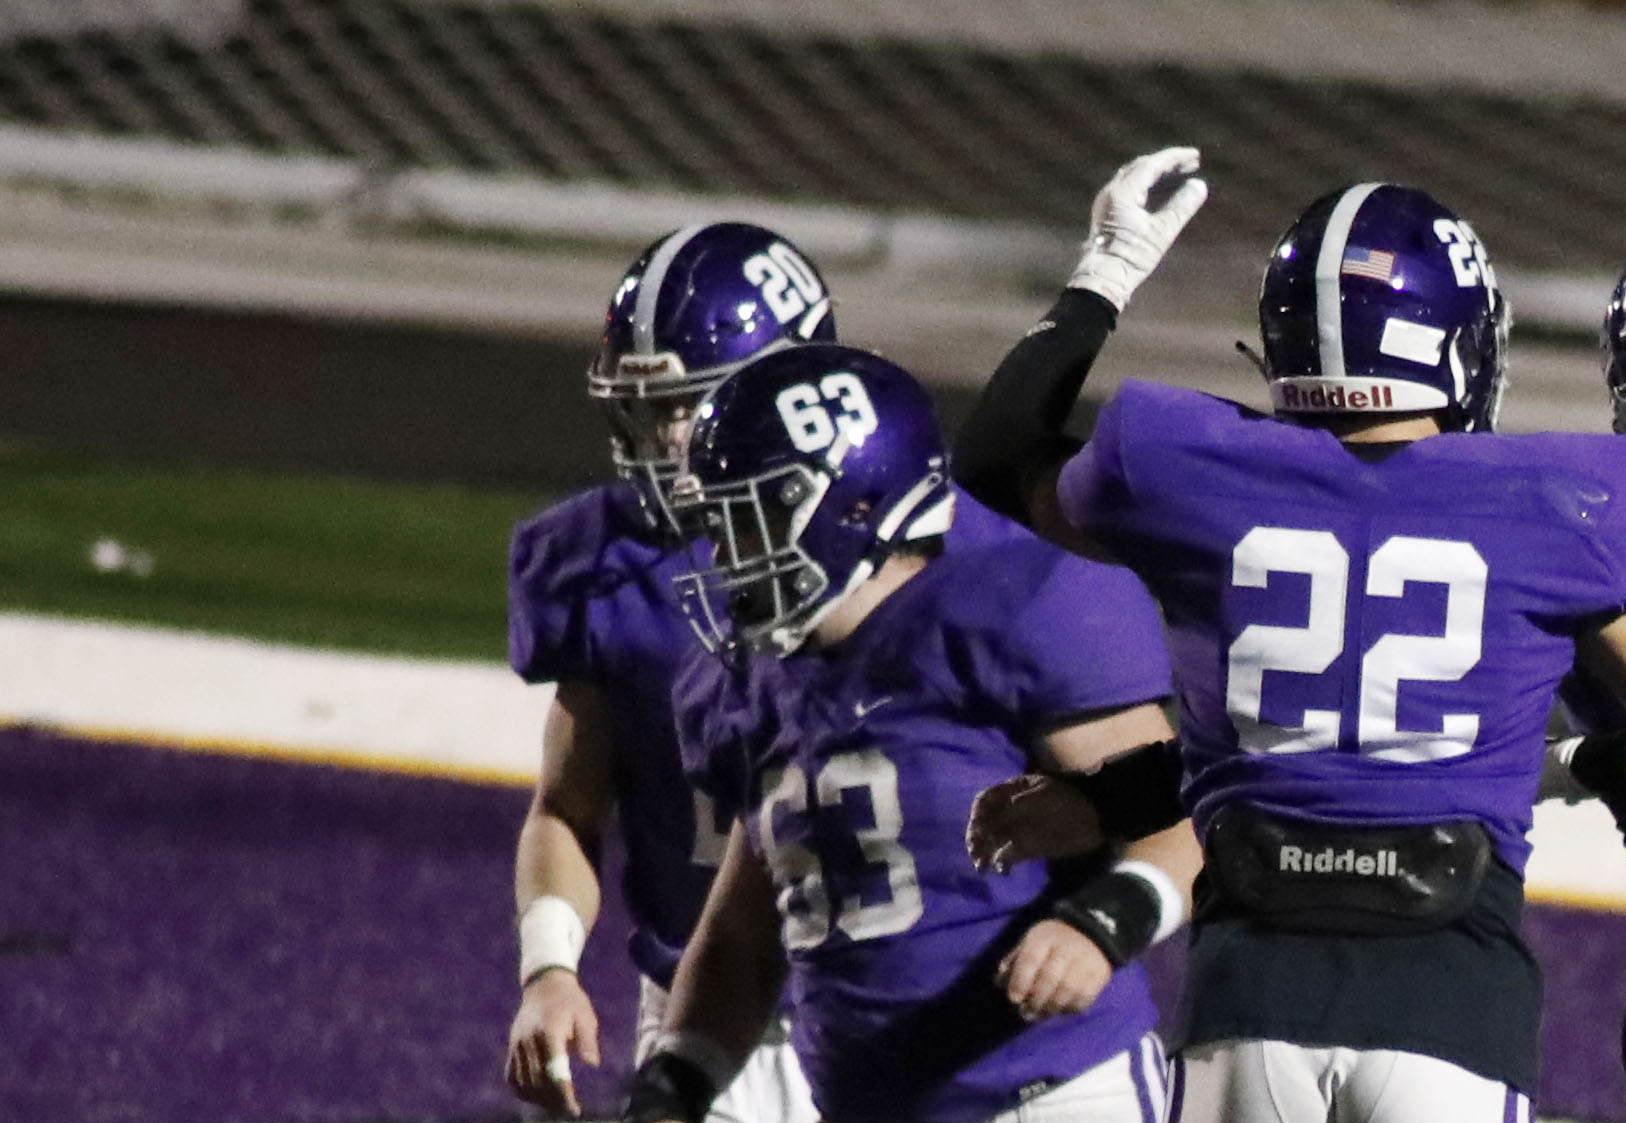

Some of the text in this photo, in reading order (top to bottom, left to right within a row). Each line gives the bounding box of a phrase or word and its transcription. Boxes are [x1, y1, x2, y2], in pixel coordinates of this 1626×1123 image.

[743, 242, 822, 324] 20
[775, 372, 879, 454] 63
[1282, 383, 1393, 409] Riddell
[1226, 526, 1488, 764] 22
[761, 750, 923, 950] 63
[1279, 845, 1397, 877] Riddell
